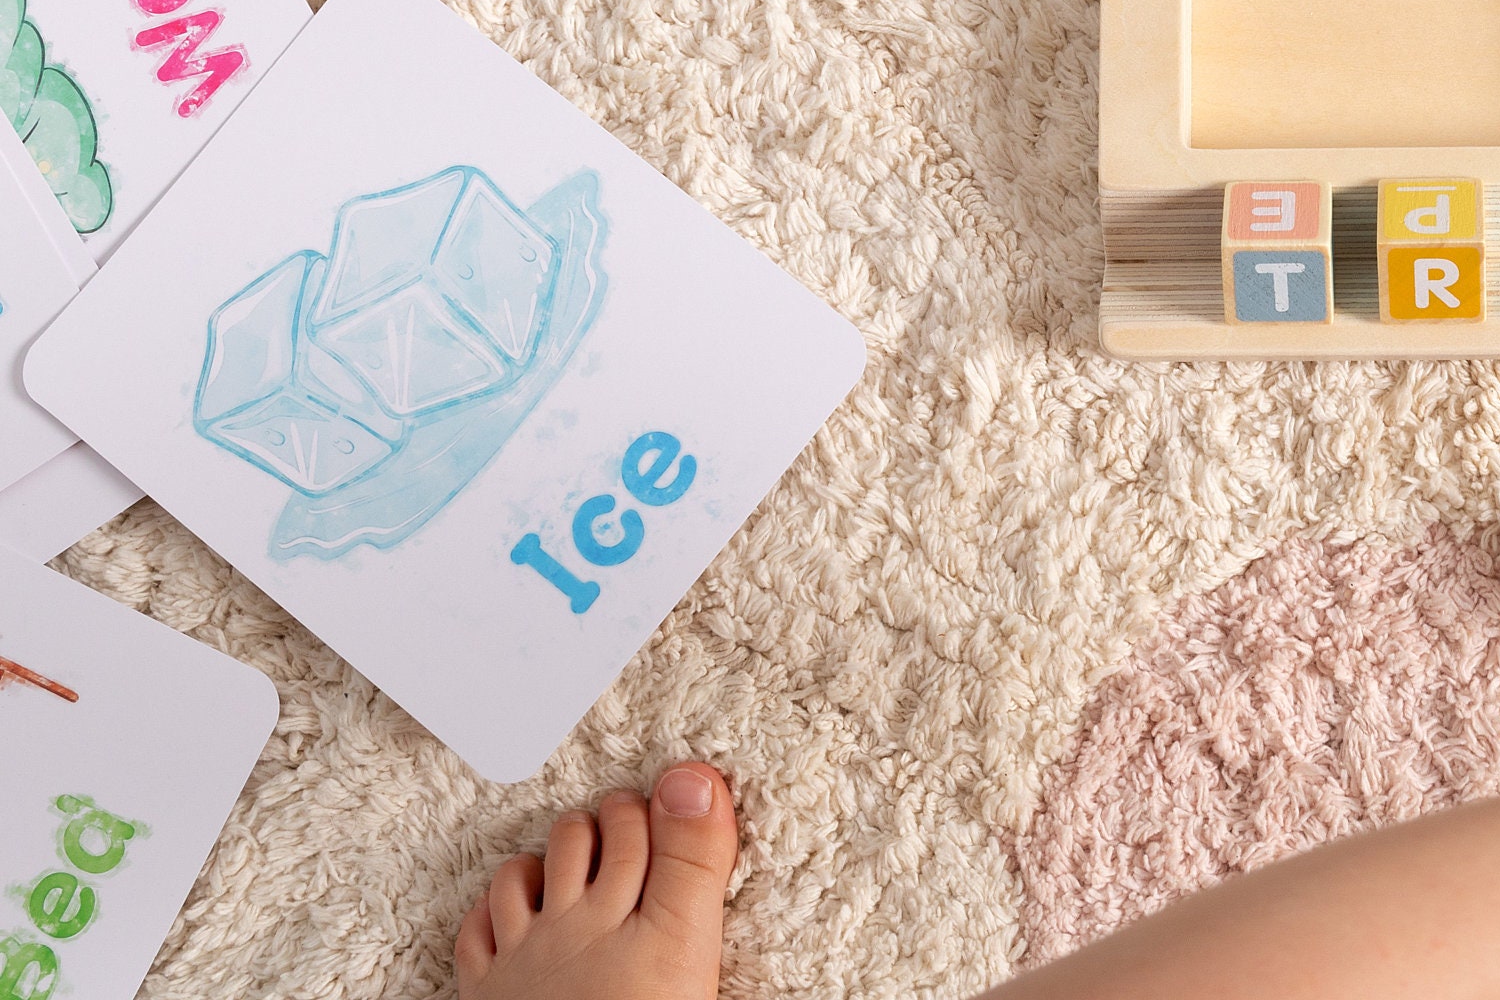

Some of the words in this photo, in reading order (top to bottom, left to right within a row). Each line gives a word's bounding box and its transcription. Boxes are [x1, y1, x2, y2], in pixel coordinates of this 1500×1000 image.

[1250, 190, 1296, 232] E
[1403, 190, 1450, 235] P
[1255, 262, 1306, 313] T
[1413, 258, 1461, 309] R
[510, 431, 697, 615] Ice
